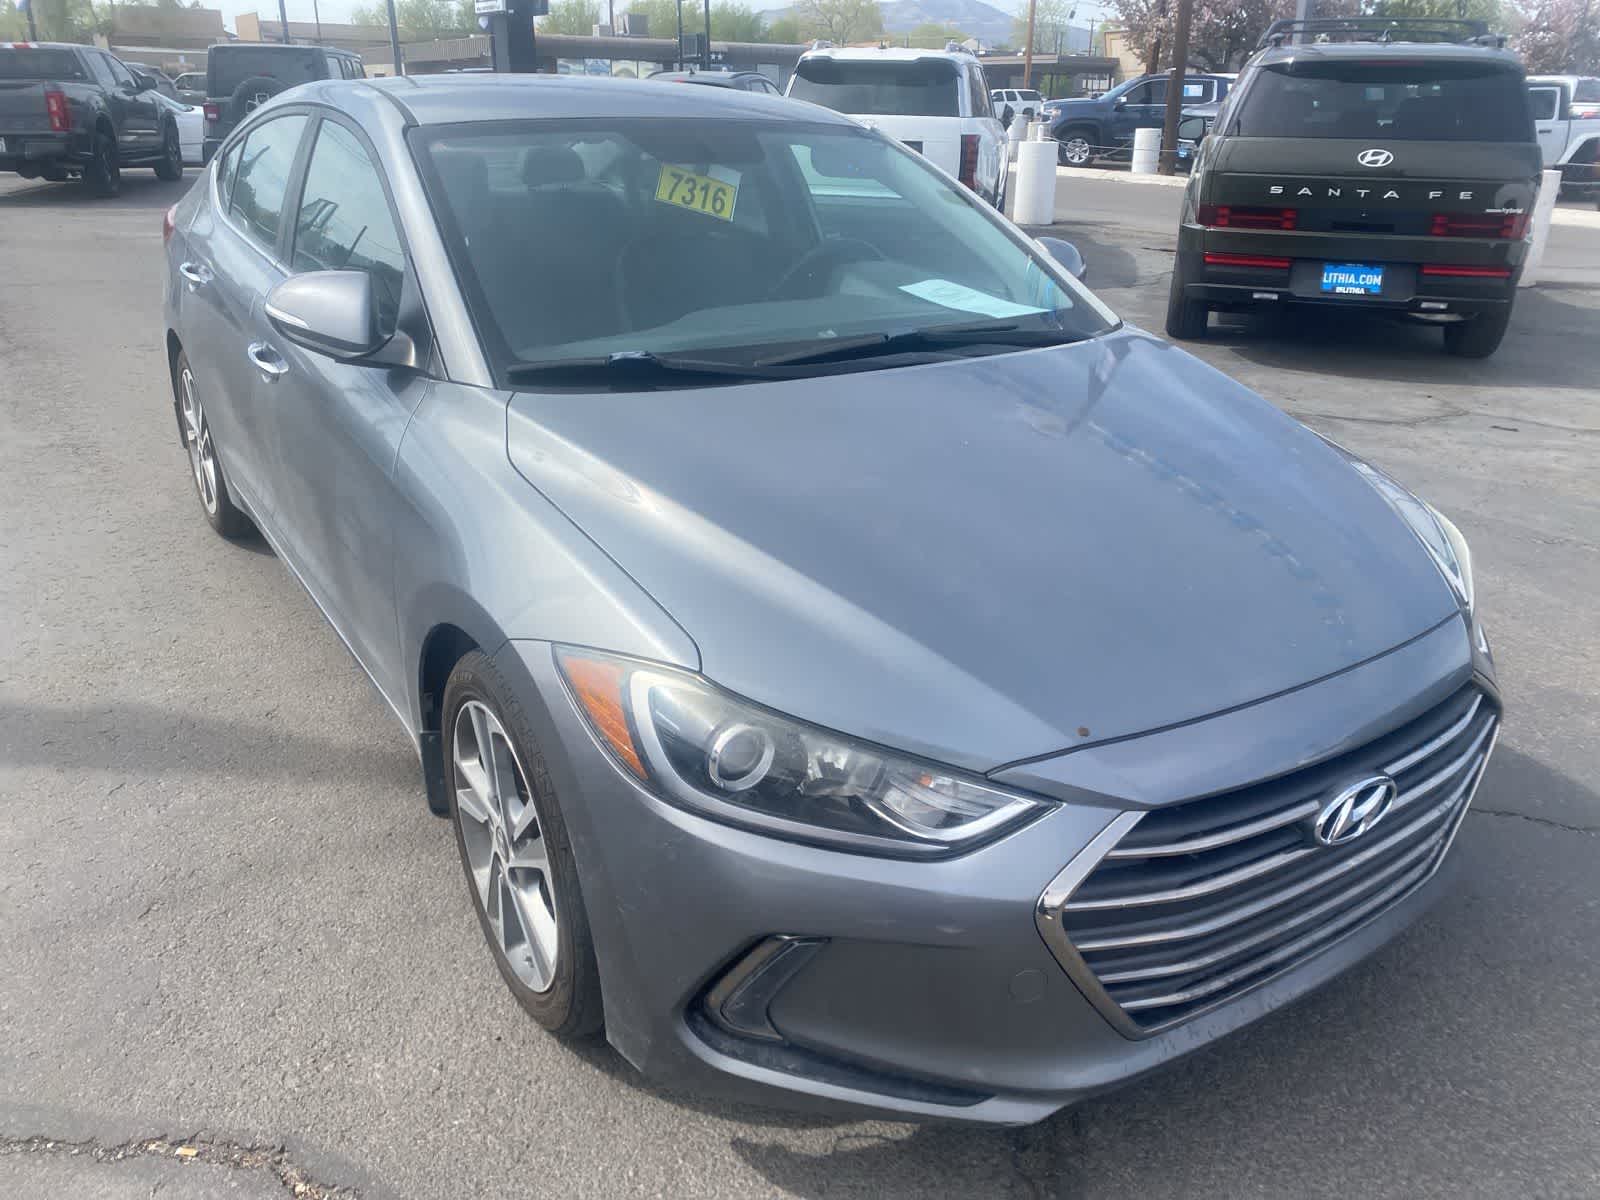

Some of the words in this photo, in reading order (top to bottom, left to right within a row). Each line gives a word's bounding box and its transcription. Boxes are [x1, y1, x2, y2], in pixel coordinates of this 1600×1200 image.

[668, 172, 726, 214] 7316
[1269, 185, 1400, 199] SANTA
[1428, 191, 1473, 200] FE
[1322, 272, 1382, 285] LITHIA.COM
